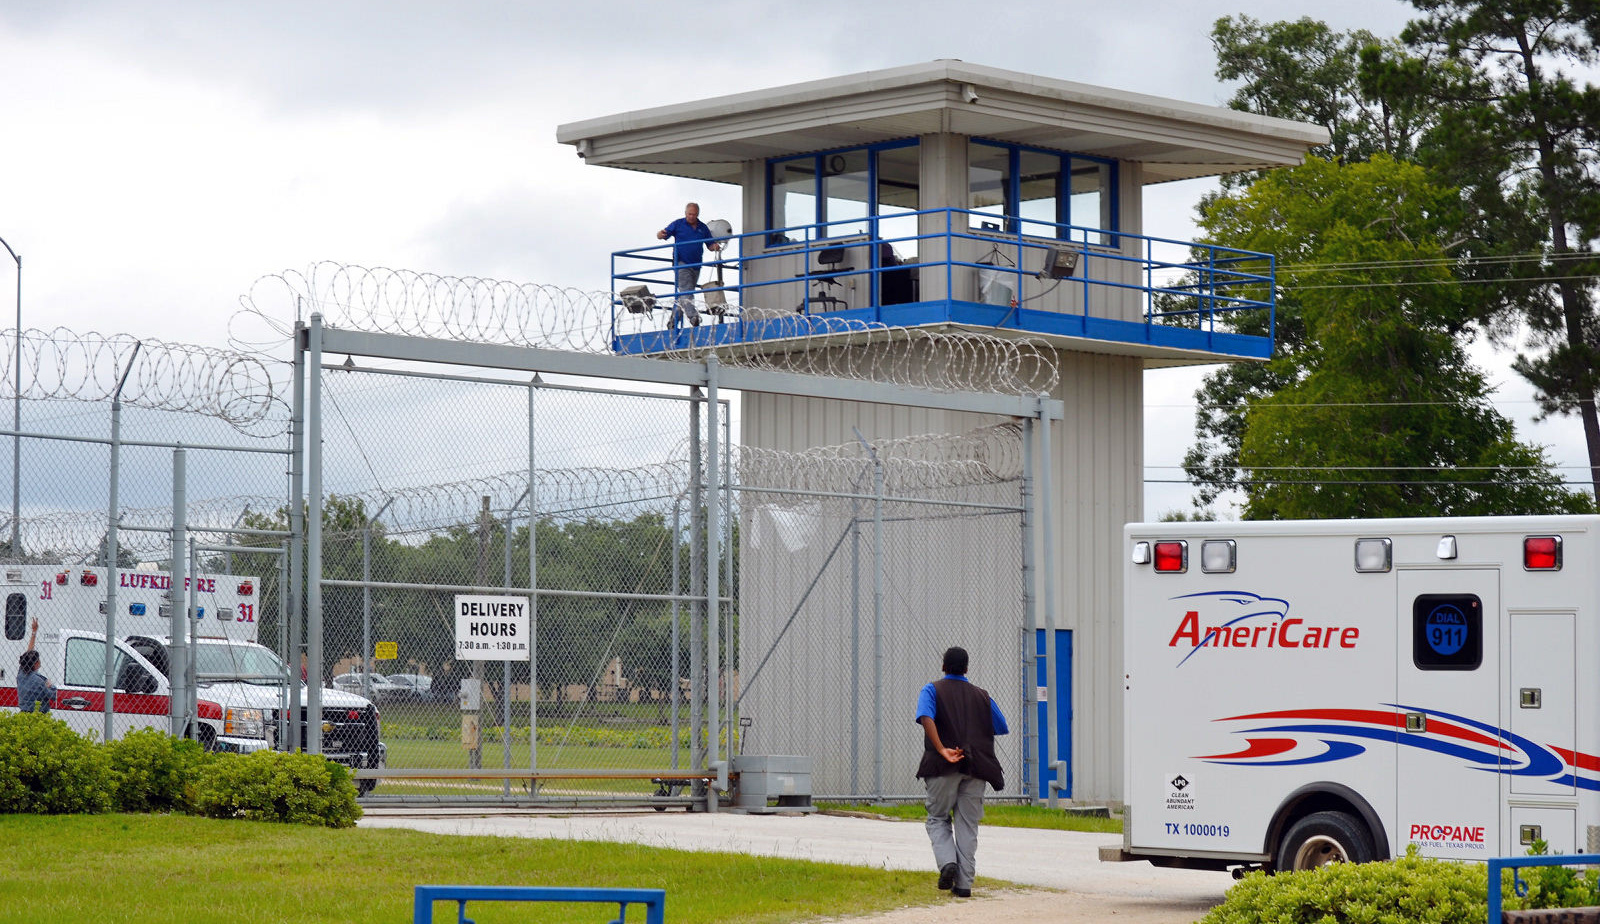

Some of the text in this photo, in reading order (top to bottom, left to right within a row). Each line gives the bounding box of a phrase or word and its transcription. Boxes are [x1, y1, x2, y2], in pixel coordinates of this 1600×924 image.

[40, 580, 52, 600] 31
[184, 577, 216, 593] FRE
[237, 603, 254, 622] 31
[461, 602, 524, 617] DELIVERY
[1436, 612, 1460, 624] DIAL
[470, 622, 517, 637] HOURS
[1168, 611, 1360, 649] AmeriCare
[1432, 627, 1462, 646] 911
[459, 641, 474, 650] 7:30
[475, 642, 491, 650] a.m.
[496, 641, 511, 650] 1:30
[512, 642, 527, 651] p.m.
[1165, 823, 1230, 837] TX 1000019
[1409, 824, 1485, 842] PROPANE
